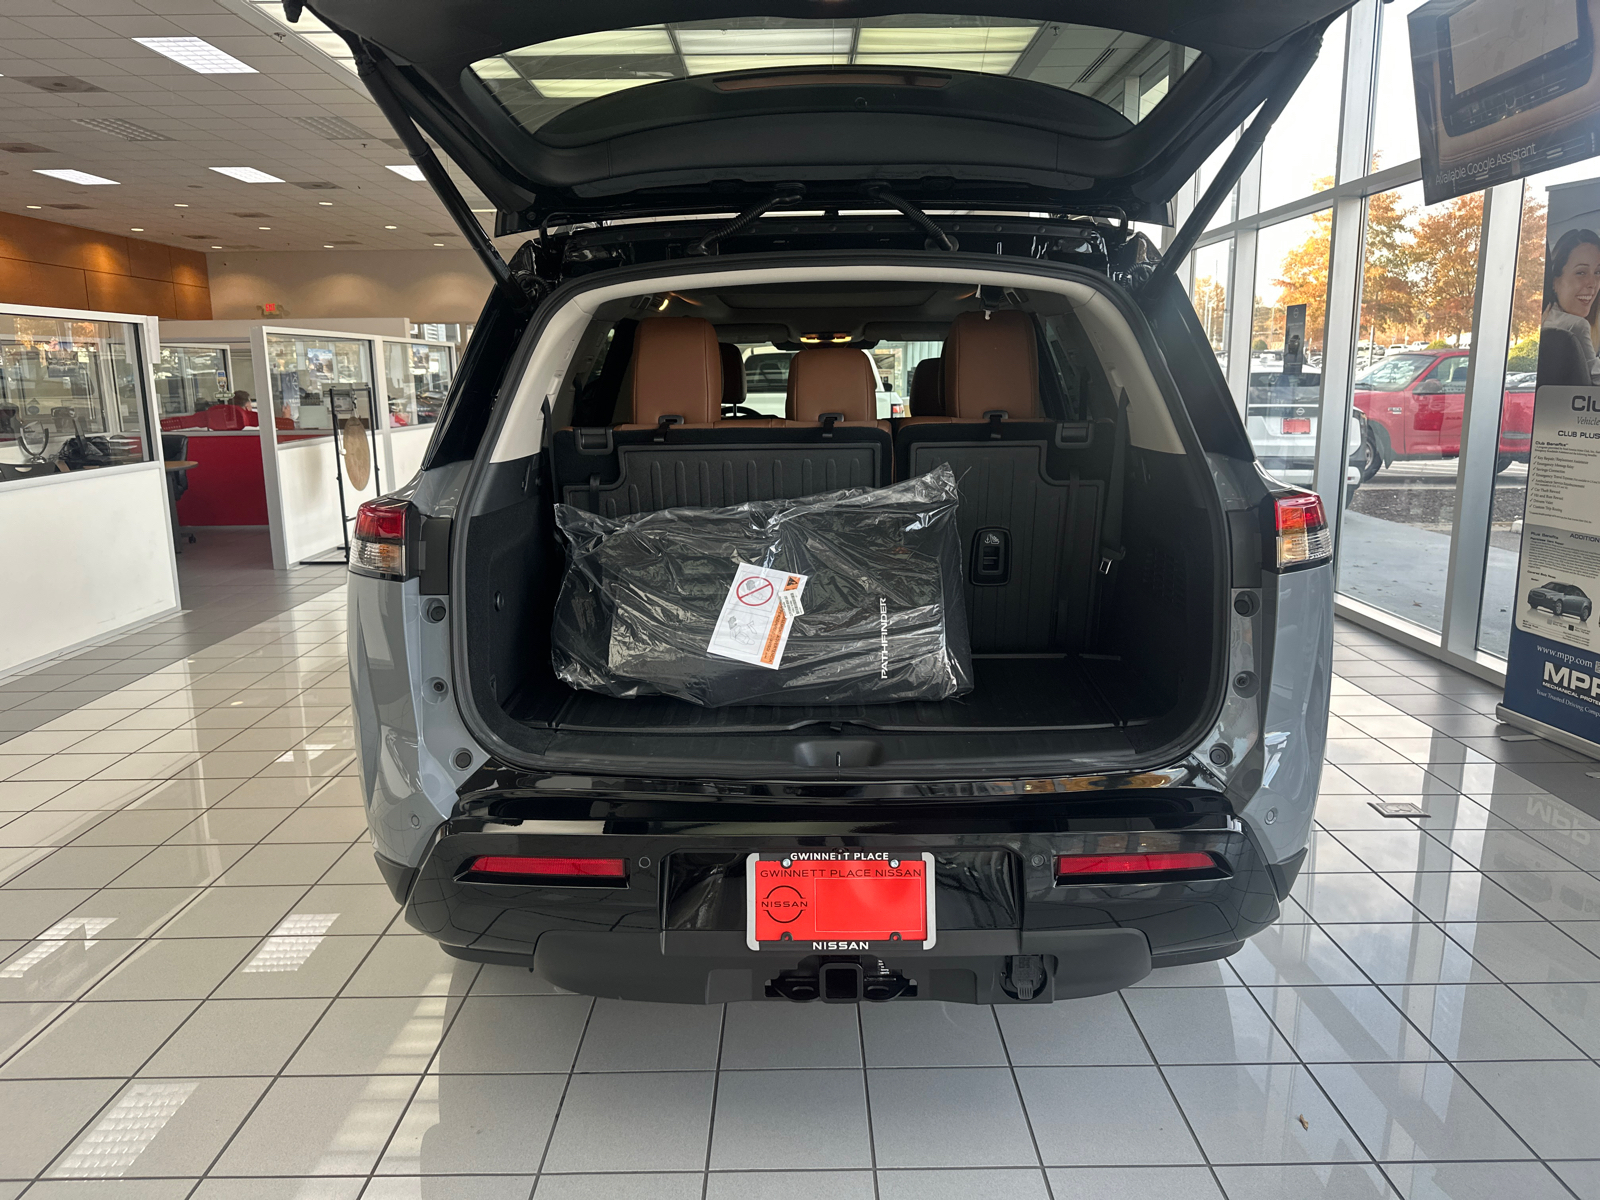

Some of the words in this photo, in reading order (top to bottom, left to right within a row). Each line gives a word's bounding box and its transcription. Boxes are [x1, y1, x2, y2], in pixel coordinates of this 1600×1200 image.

[1436, 166, 1466, 186] Available
[1466, 157, 1496, 176] Google
[1496, 142, 1536, 166] Assistant
[1577, 416, 1600, 426] Vehicle
[880, 598, 888, 679] PATHFINDER
[1536, 645, 1593, 668] www.mpp.com
[1542, 682, 1579, 698] MECHANICAL
[1580, 694, 1600, 706] PROTE
[1566, 700, 1584, 712] Driving
